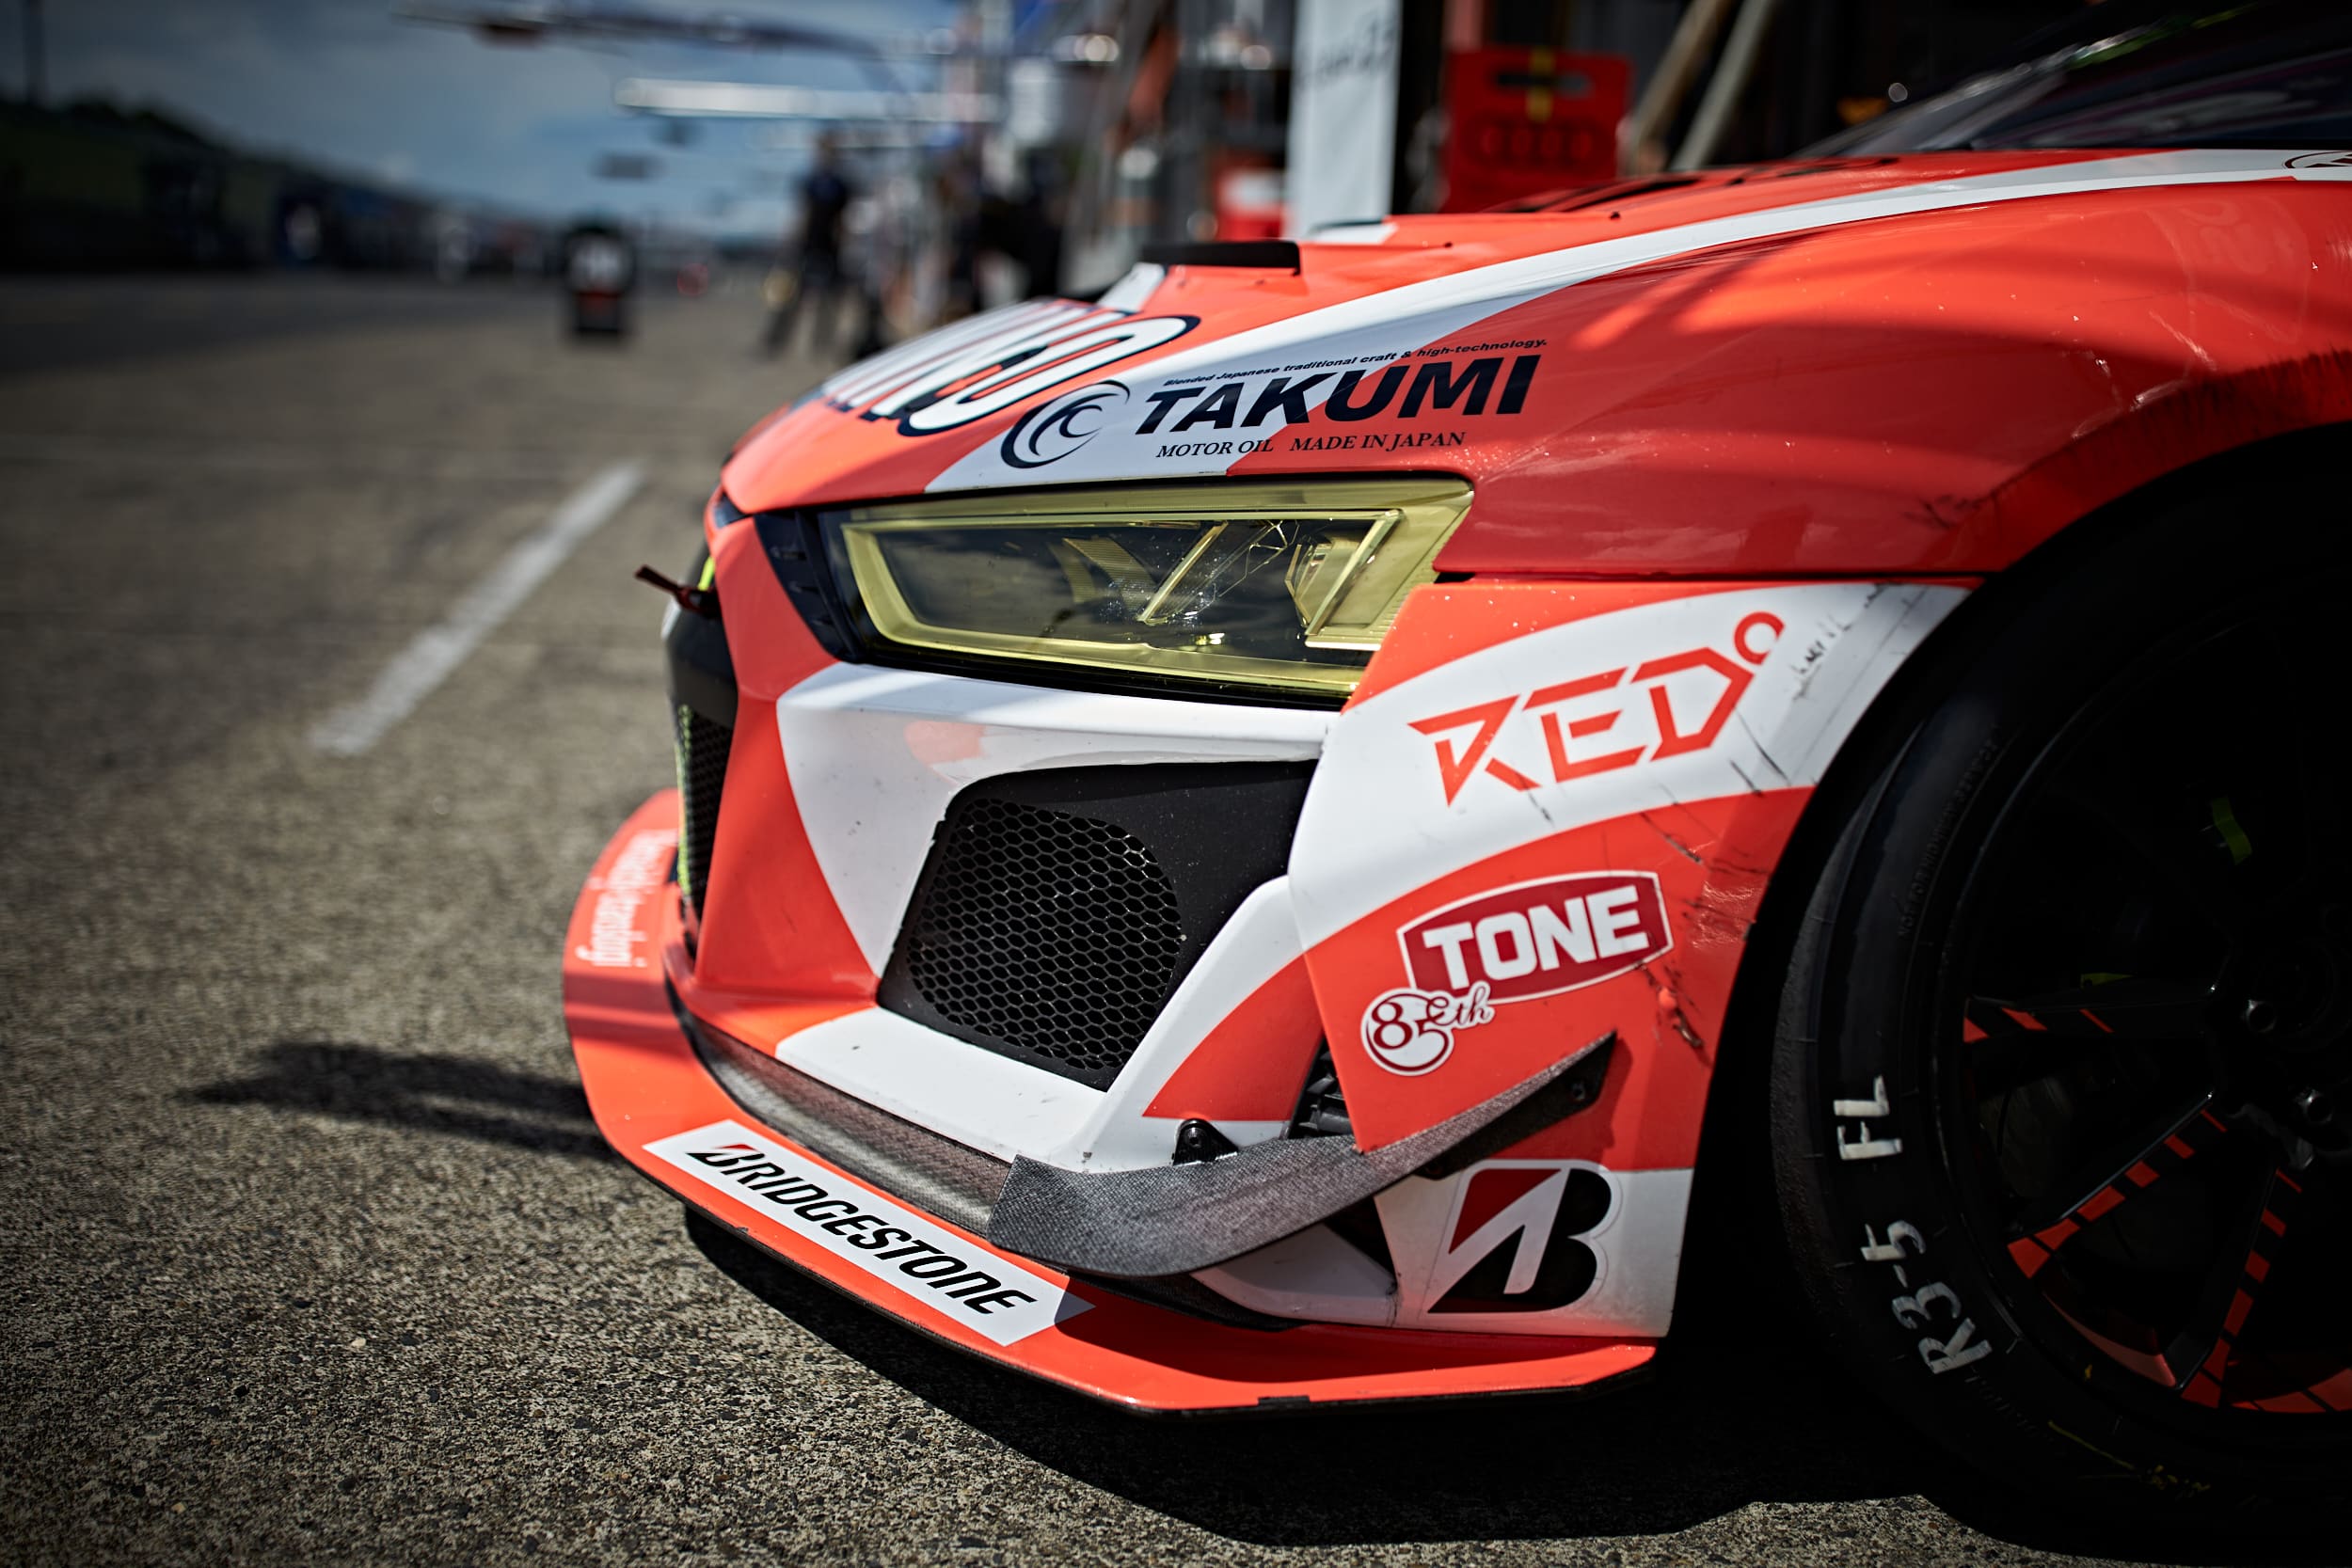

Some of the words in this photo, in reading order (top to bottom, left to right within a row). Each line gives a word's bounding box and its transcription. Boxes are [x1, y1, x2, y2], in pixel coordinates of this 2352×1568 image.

[1135, 354, 1542, 436] TAKUMI
[1216, 365, 1280, 381] Japanese
[1283, 356, 1358, 373] traditional
[1360, 350, 1399, 366] craft
[1401, 351, 1412, 359] &
[1417, 339, 1548, 358] high-technology.
[1155, 441, 1232, 458] MOTOR
[1238, 439, 1274, 454] OIL
[1289, 436, 1359, 452] MADE
[1362, 434, 1390, 450] IN
[1386, 432, 1468, 452] JAPAN
[1422, 884, 1649, 990] TONE
[1833, 1074, 1903, 1161] FL
[685, 1143, 1038, 1315] BRIDGESTONE
